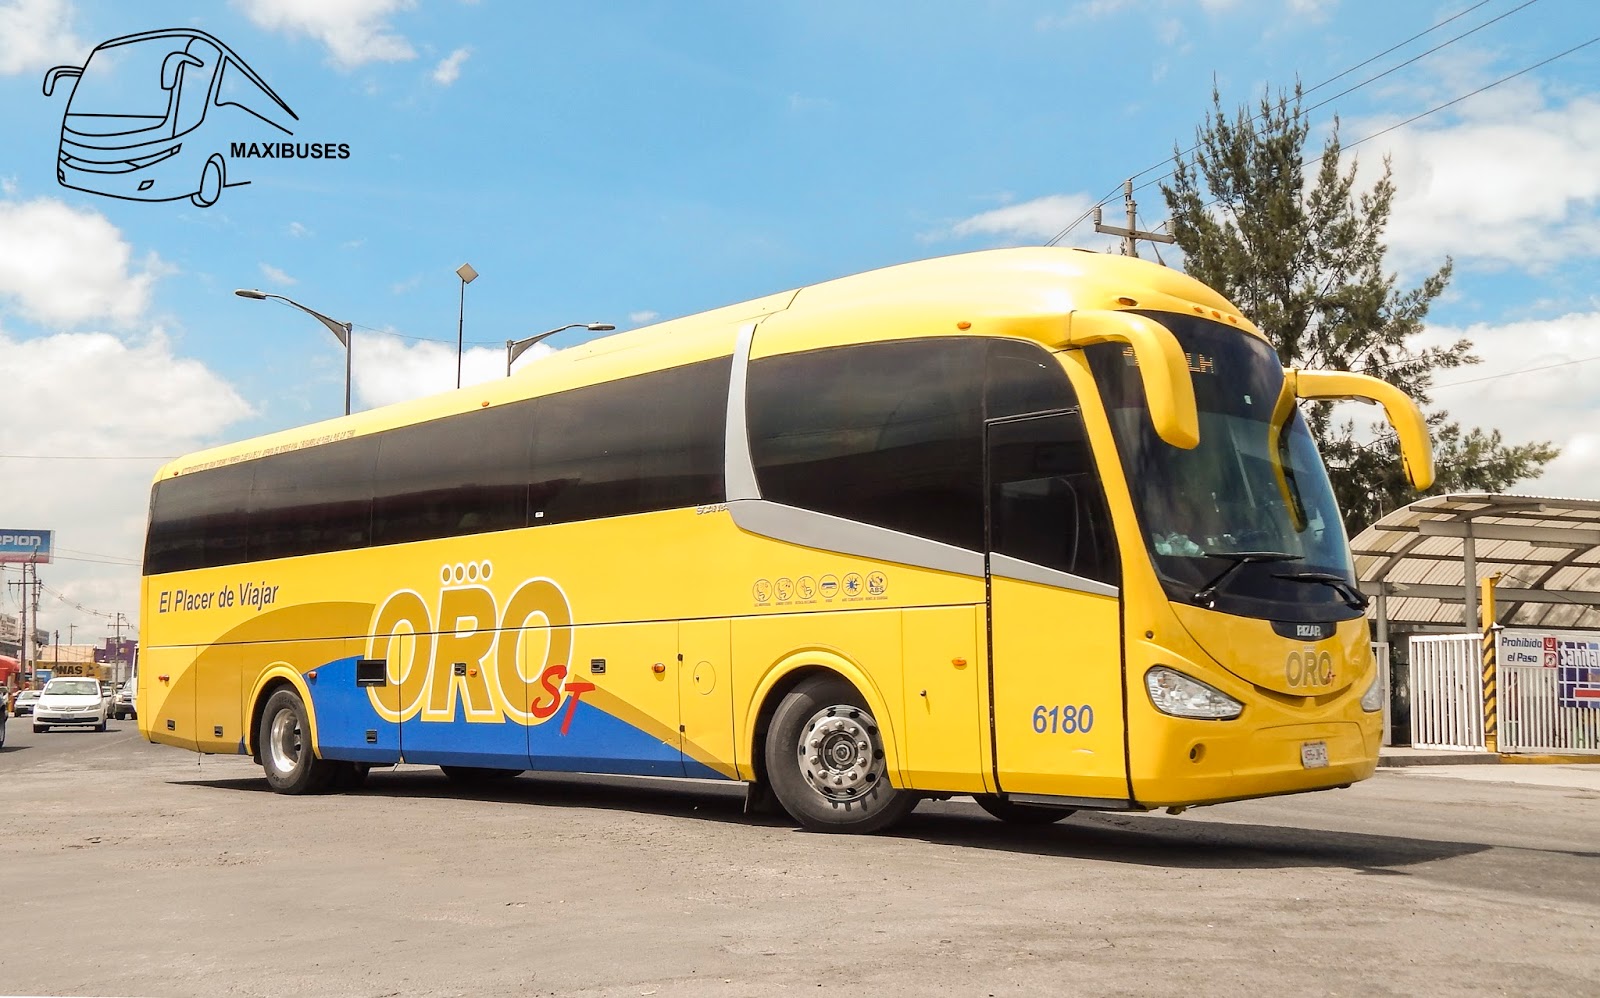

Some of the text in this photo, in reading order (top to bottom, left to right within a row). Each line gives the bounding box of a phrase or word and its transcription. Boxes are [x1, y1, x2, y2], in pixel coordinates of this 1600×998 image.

[0, 535, 42, 546] PION
[159, 581, 280, 613] El Placer de Viajar
[366, 576, 575, 725] ORO
[1501, 637, 1542, 648] Prohibido
[1507, 652, 1538, 663] el Paso
[1285, 650, 1332, 688] ORO
[531, 664, 596, 736] ST
[1031, 704, 1094, 735] 6180
